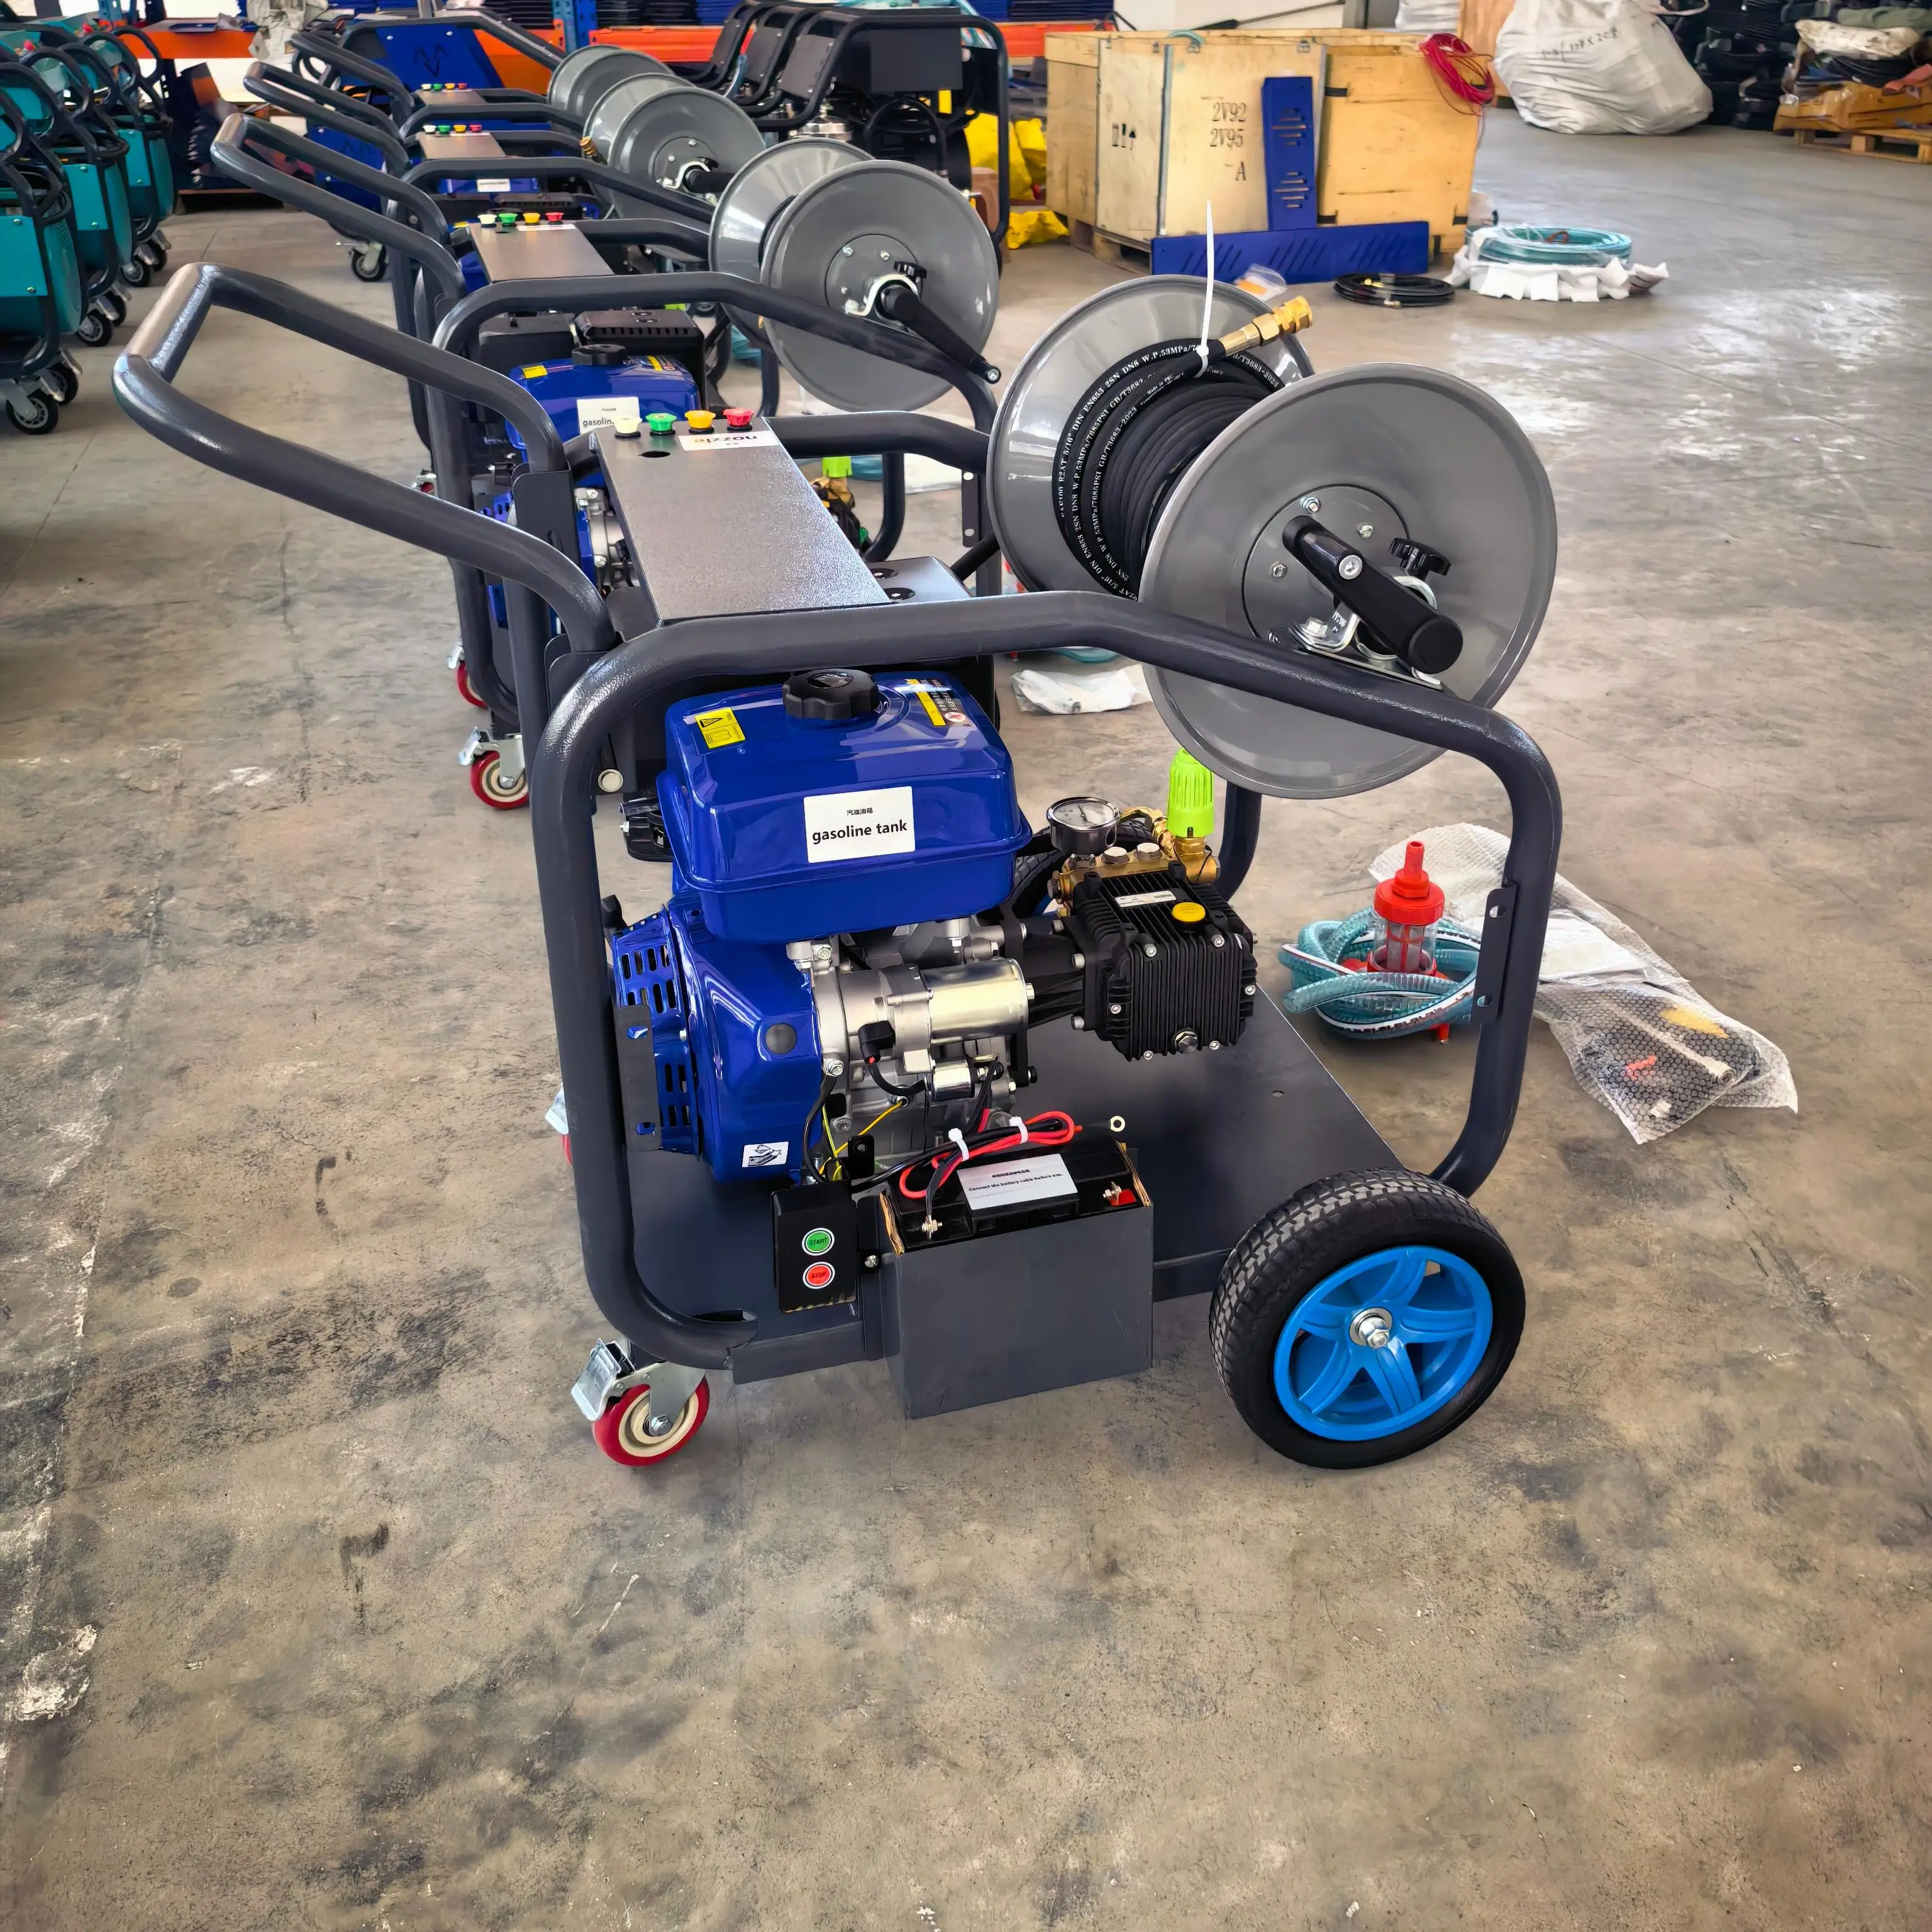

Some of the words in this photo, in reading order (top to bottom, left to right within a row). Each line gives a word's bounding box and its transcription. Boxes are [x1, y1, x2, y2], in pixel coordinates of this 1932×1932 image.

[1059, 458, 1067, 482] R2AT
[1072, 414, 1085, 431] DIN
[1083, 387, 1104, 413] EN853
[1104, 372, 1121, 387] 2SN
[1121, 360, 1140, 374] DN8
[1141, 345, 1199, 363] W.P.53MPa/7
[1233, 353, 1279, 388] B/T3683-2023
[582, 417, 615, 428] gasolin
[1072, 515, 1082, 531] 2SN
[1077, 534, 1092, 558] EN853
[1089, 560, 1103, 574] DIN
[1105, 553, 1118, 569] DN8
[1116, 568, 1130, 582] 2SN
[812, 825, 872, 845] gasoline
[876, 819, 908, 834] tank
